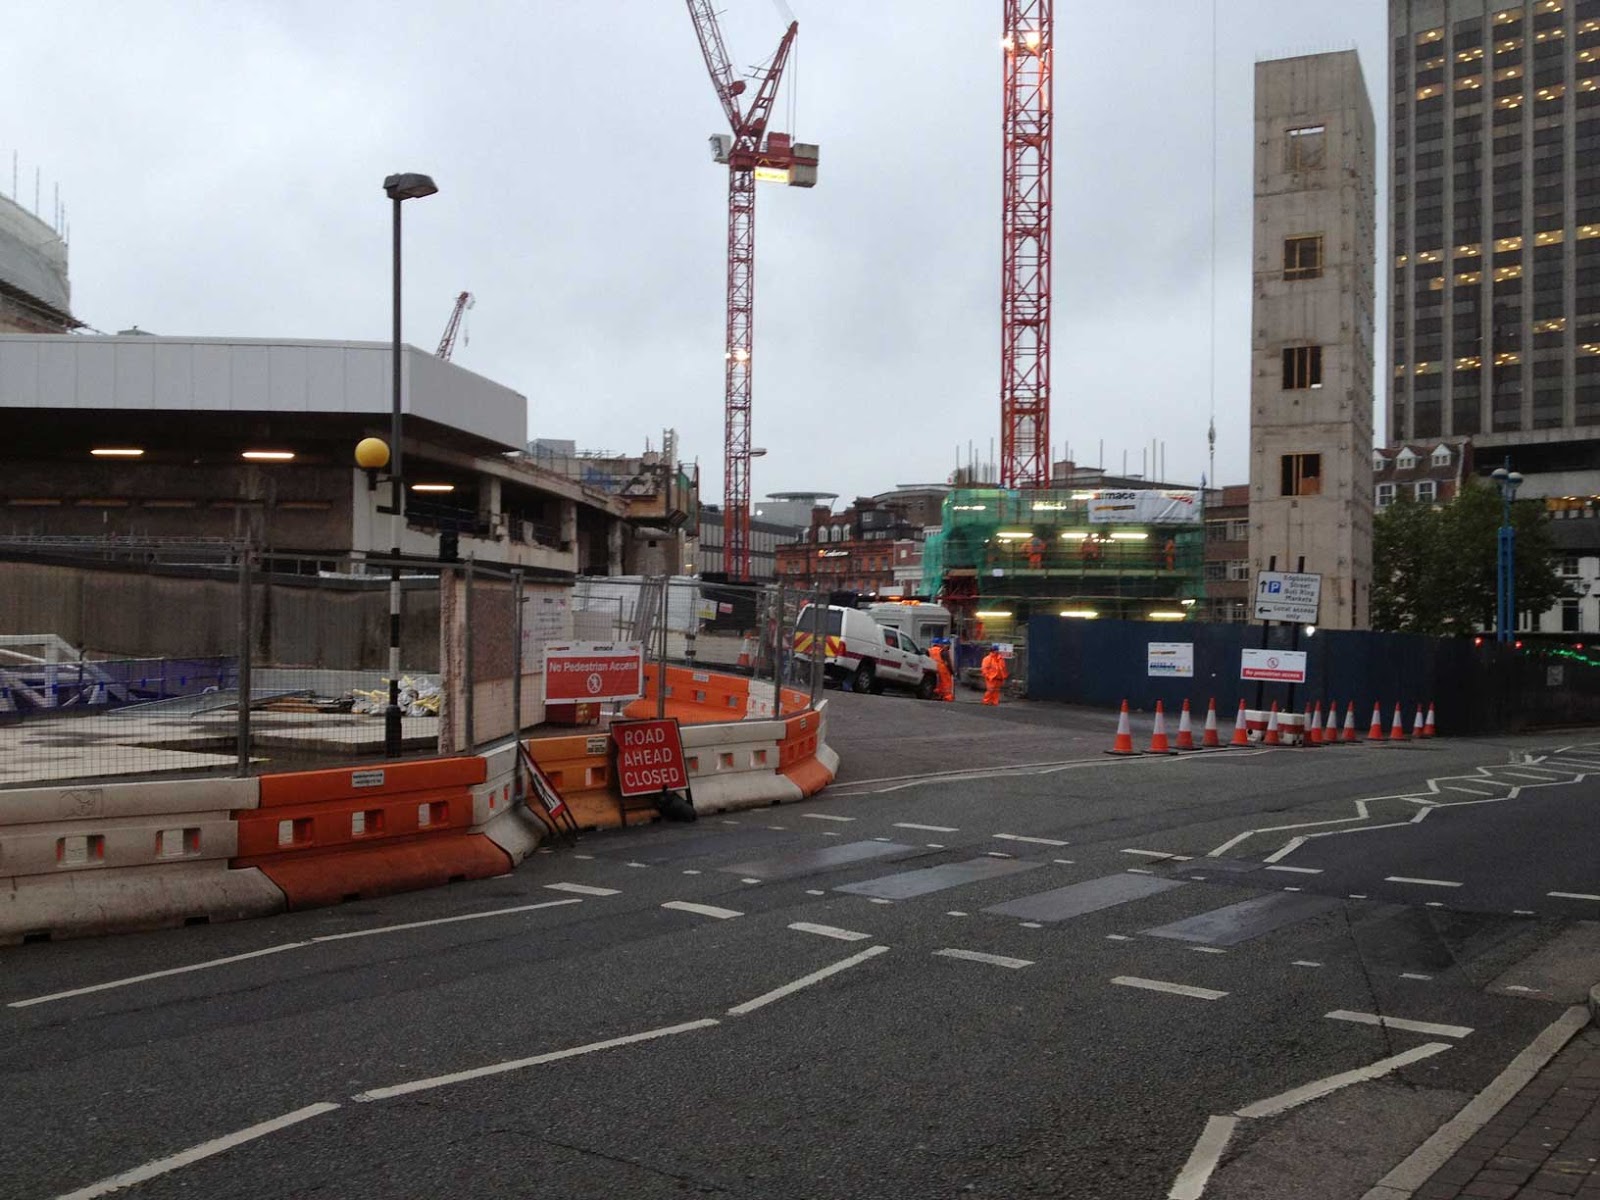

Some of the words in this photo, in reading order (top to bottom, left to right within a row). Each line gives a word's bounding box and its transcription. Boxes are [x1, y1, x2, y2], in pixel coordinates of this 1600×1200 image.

[549, 662, 561, 672] No
[563, 661, 608, 672] Pedestrian
[609, 661, 638, 671] Access
[624, 728, 665, 745] ROAD
[624, 747, 672, 766] AHEAD
[625, 767, 679, 787] CLOSED
